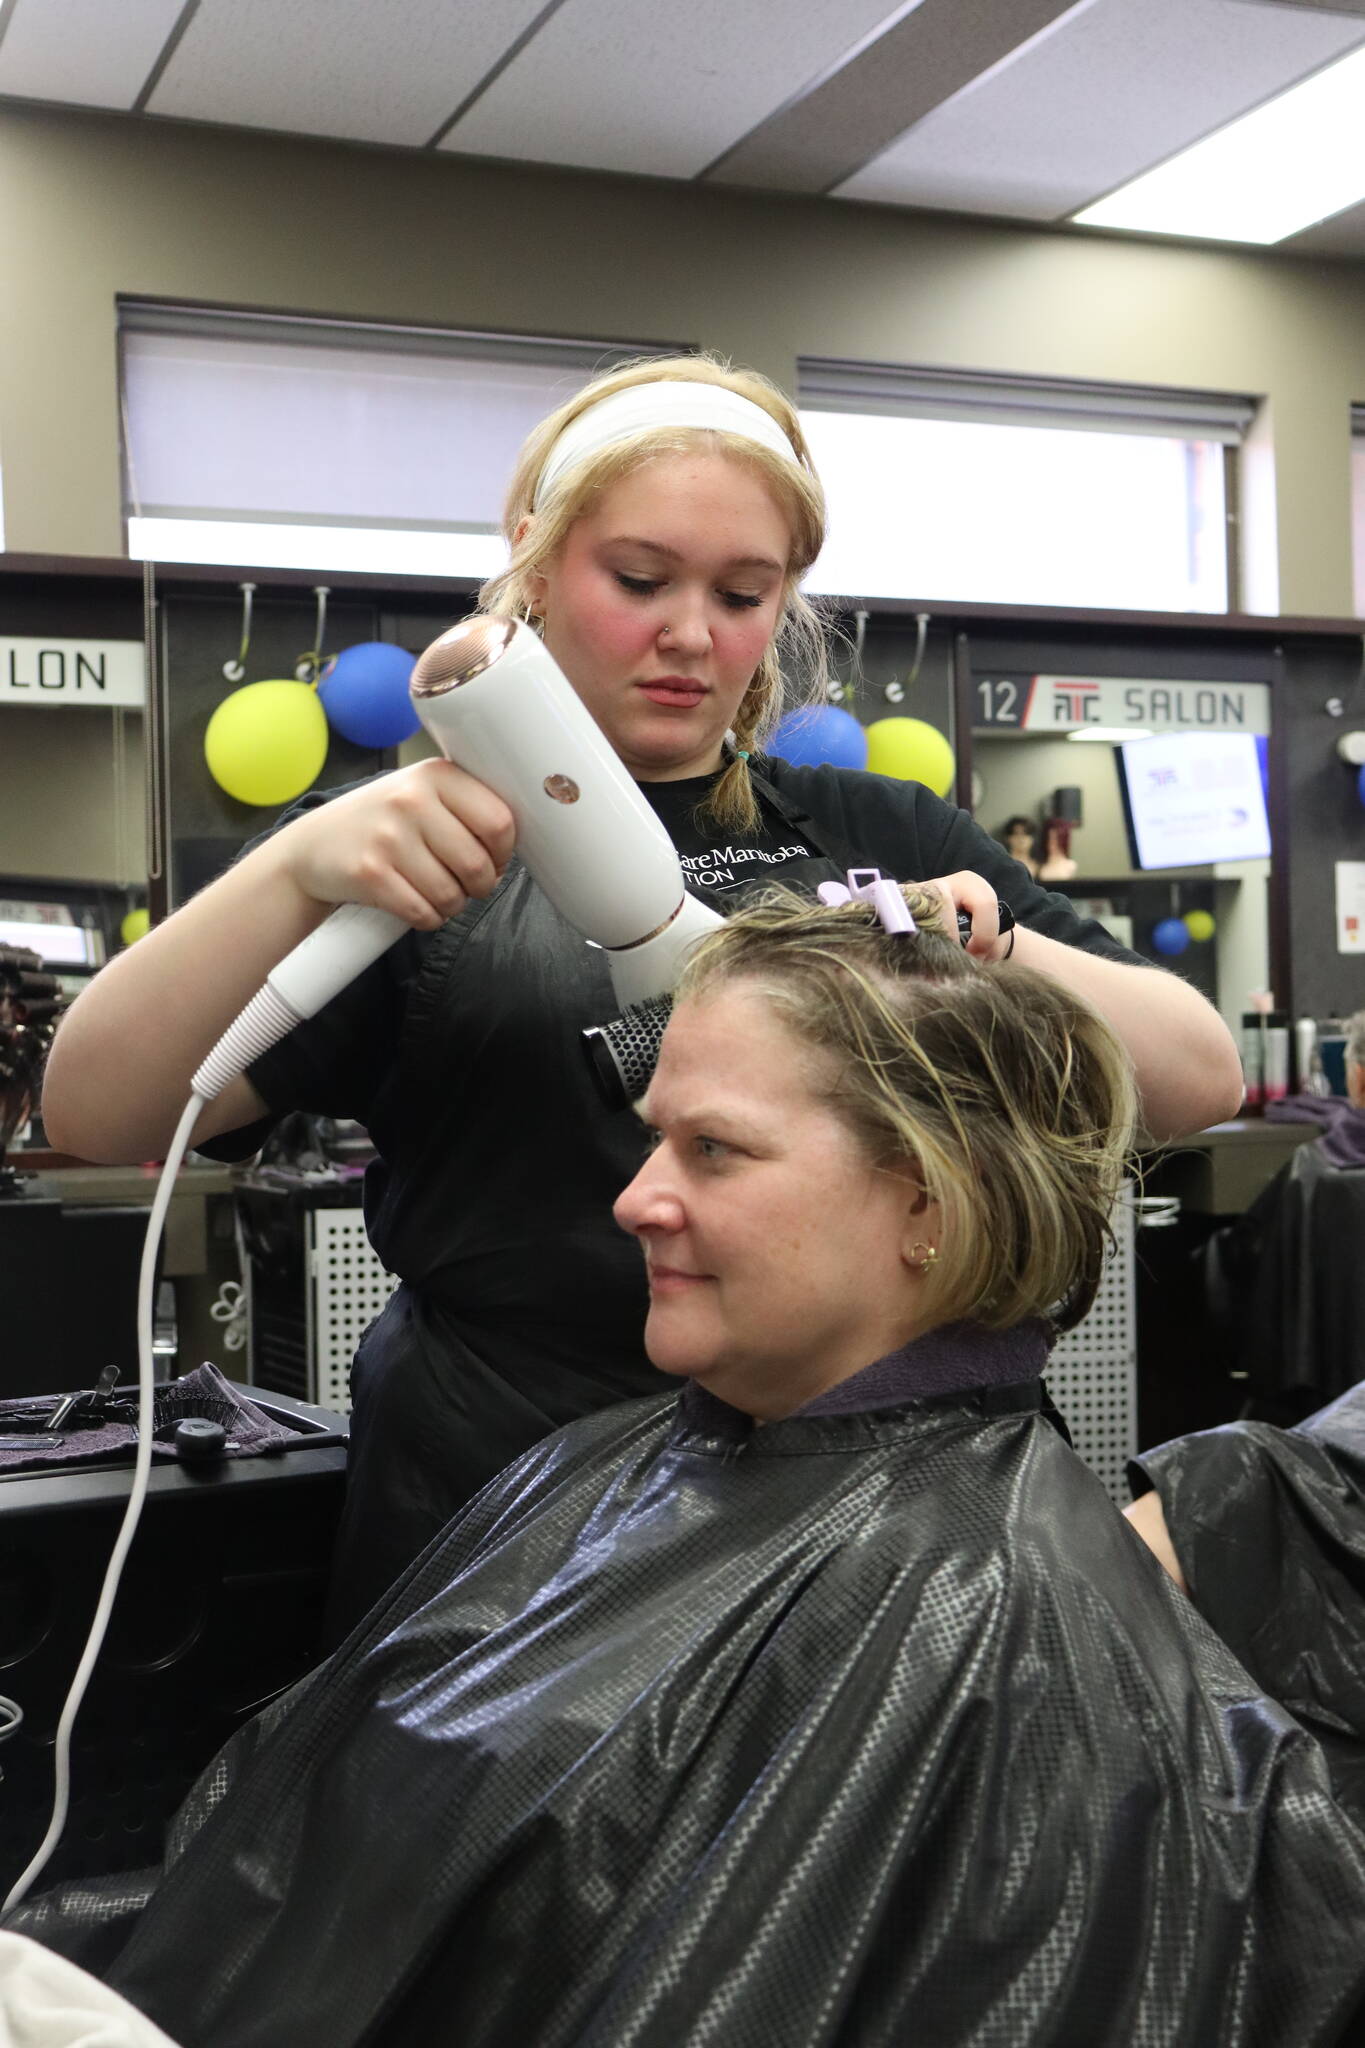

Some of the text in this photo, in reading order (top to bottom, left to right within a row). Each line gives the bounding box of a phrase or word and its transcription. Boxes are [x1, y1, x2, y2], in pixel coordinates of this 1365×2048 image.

[10, 649, 105, 690] LON
[978, 680, 1017, 721] 12
[1124, 688, 1245, 724] SALON
